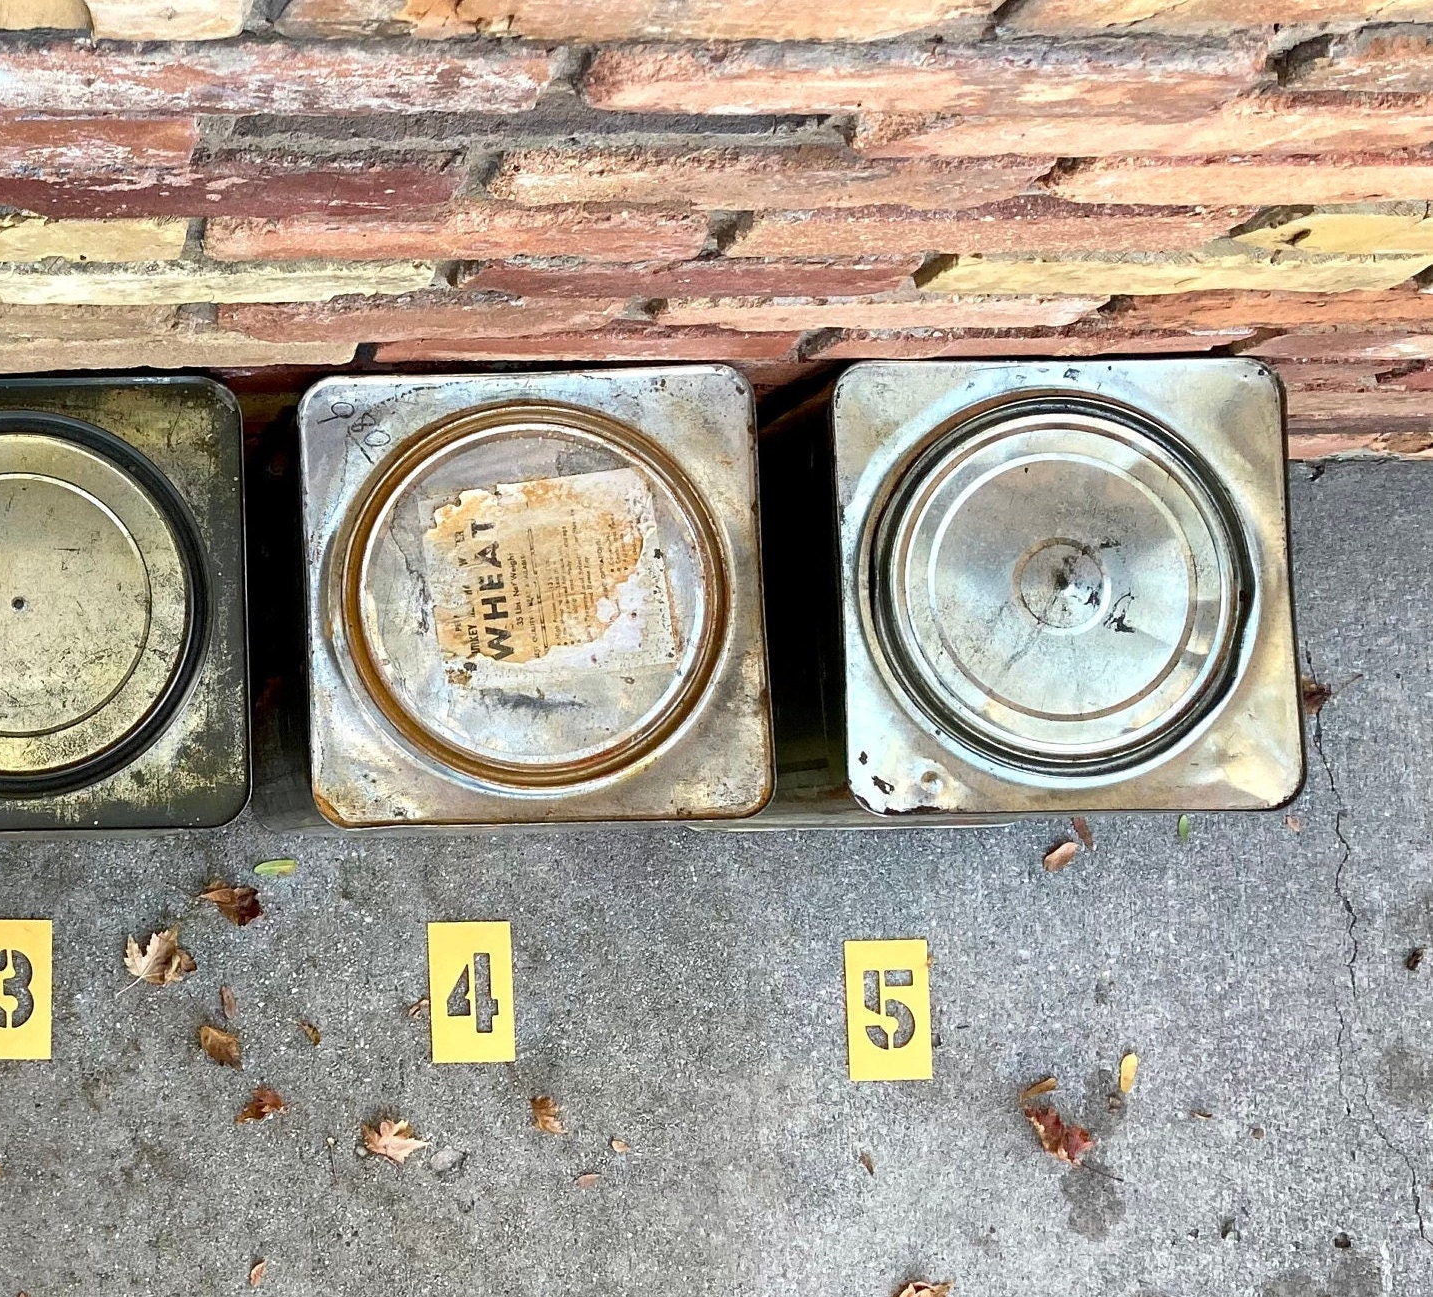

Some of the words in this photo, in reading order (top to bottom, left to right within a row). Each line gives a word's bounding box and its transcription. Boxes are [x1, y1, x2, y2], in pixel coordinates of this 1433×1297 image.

[471, 518, 514, 661] WHEAT
[516, 616, 523, 625] 35
[447, 952, 498, 1034] 4
[863, 969, 915, 1050] 5
